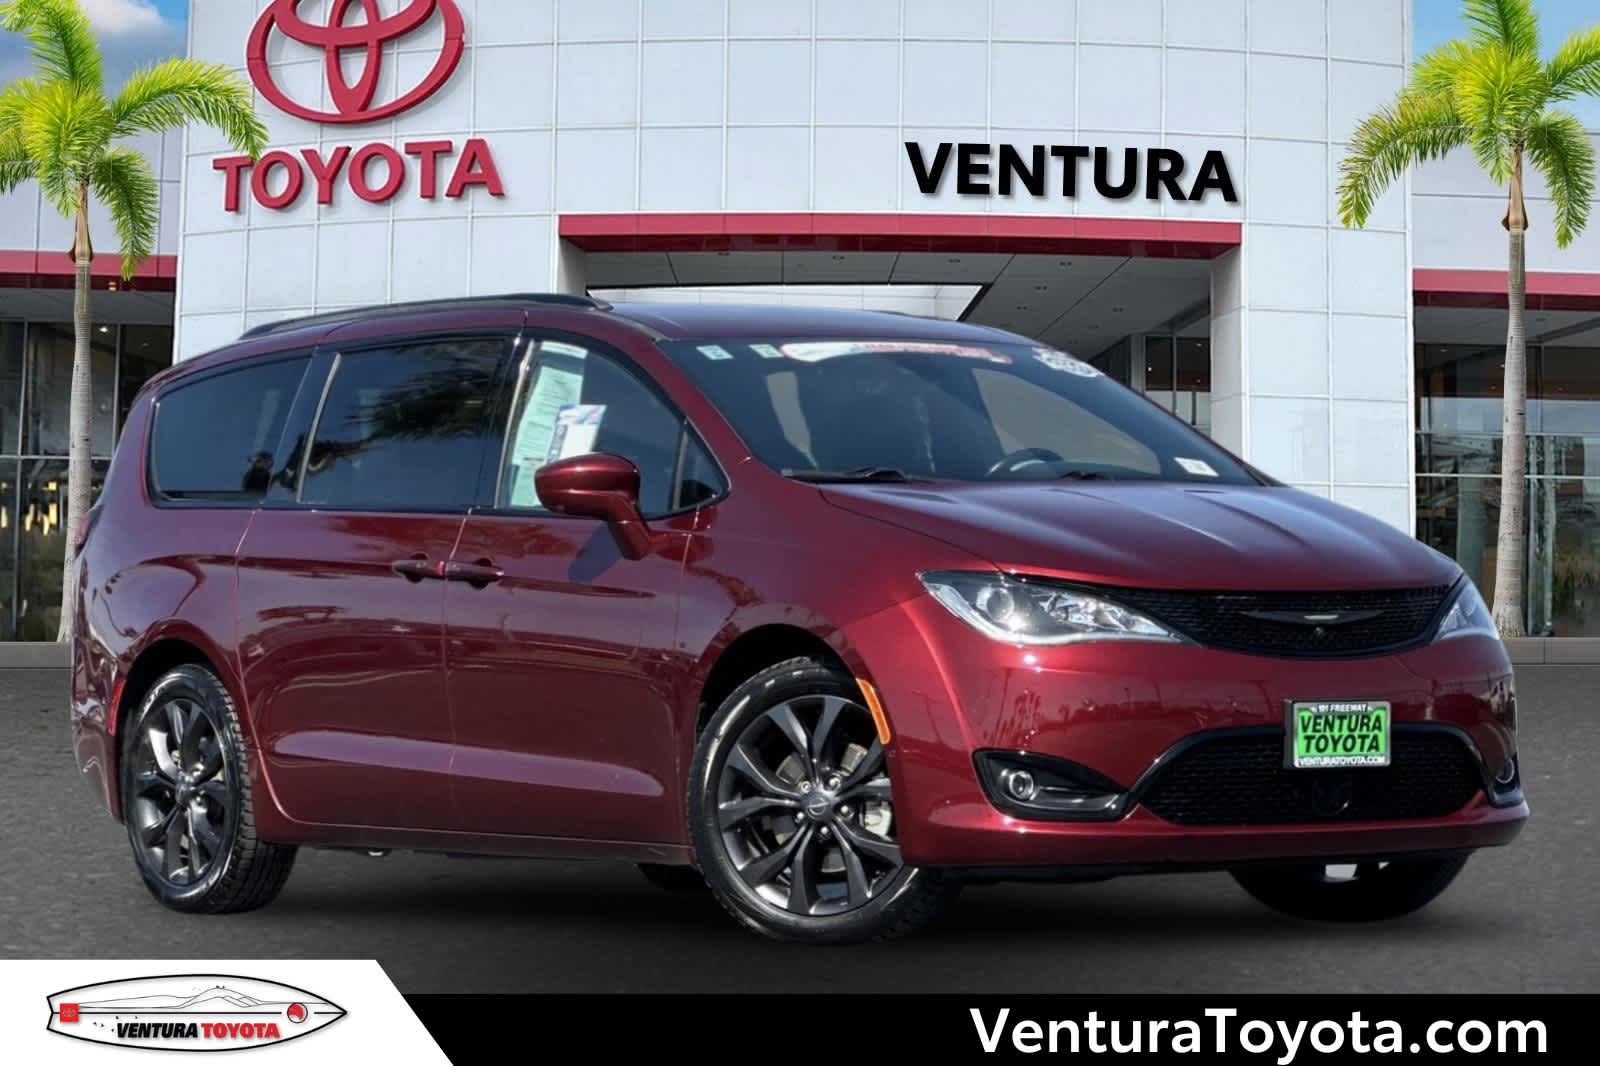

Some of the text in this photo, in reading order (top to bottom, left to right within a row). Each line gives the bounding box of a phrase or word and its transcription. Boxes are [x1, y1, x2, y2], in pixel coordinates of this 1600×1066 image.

[213, 139, 504, 212] TOYOTA
[904, 141, 1238, 203] VENTURA
[1301, 715, 1382, 733] VENTURA
[1303, 734, 1380, 753] TOYOTA
